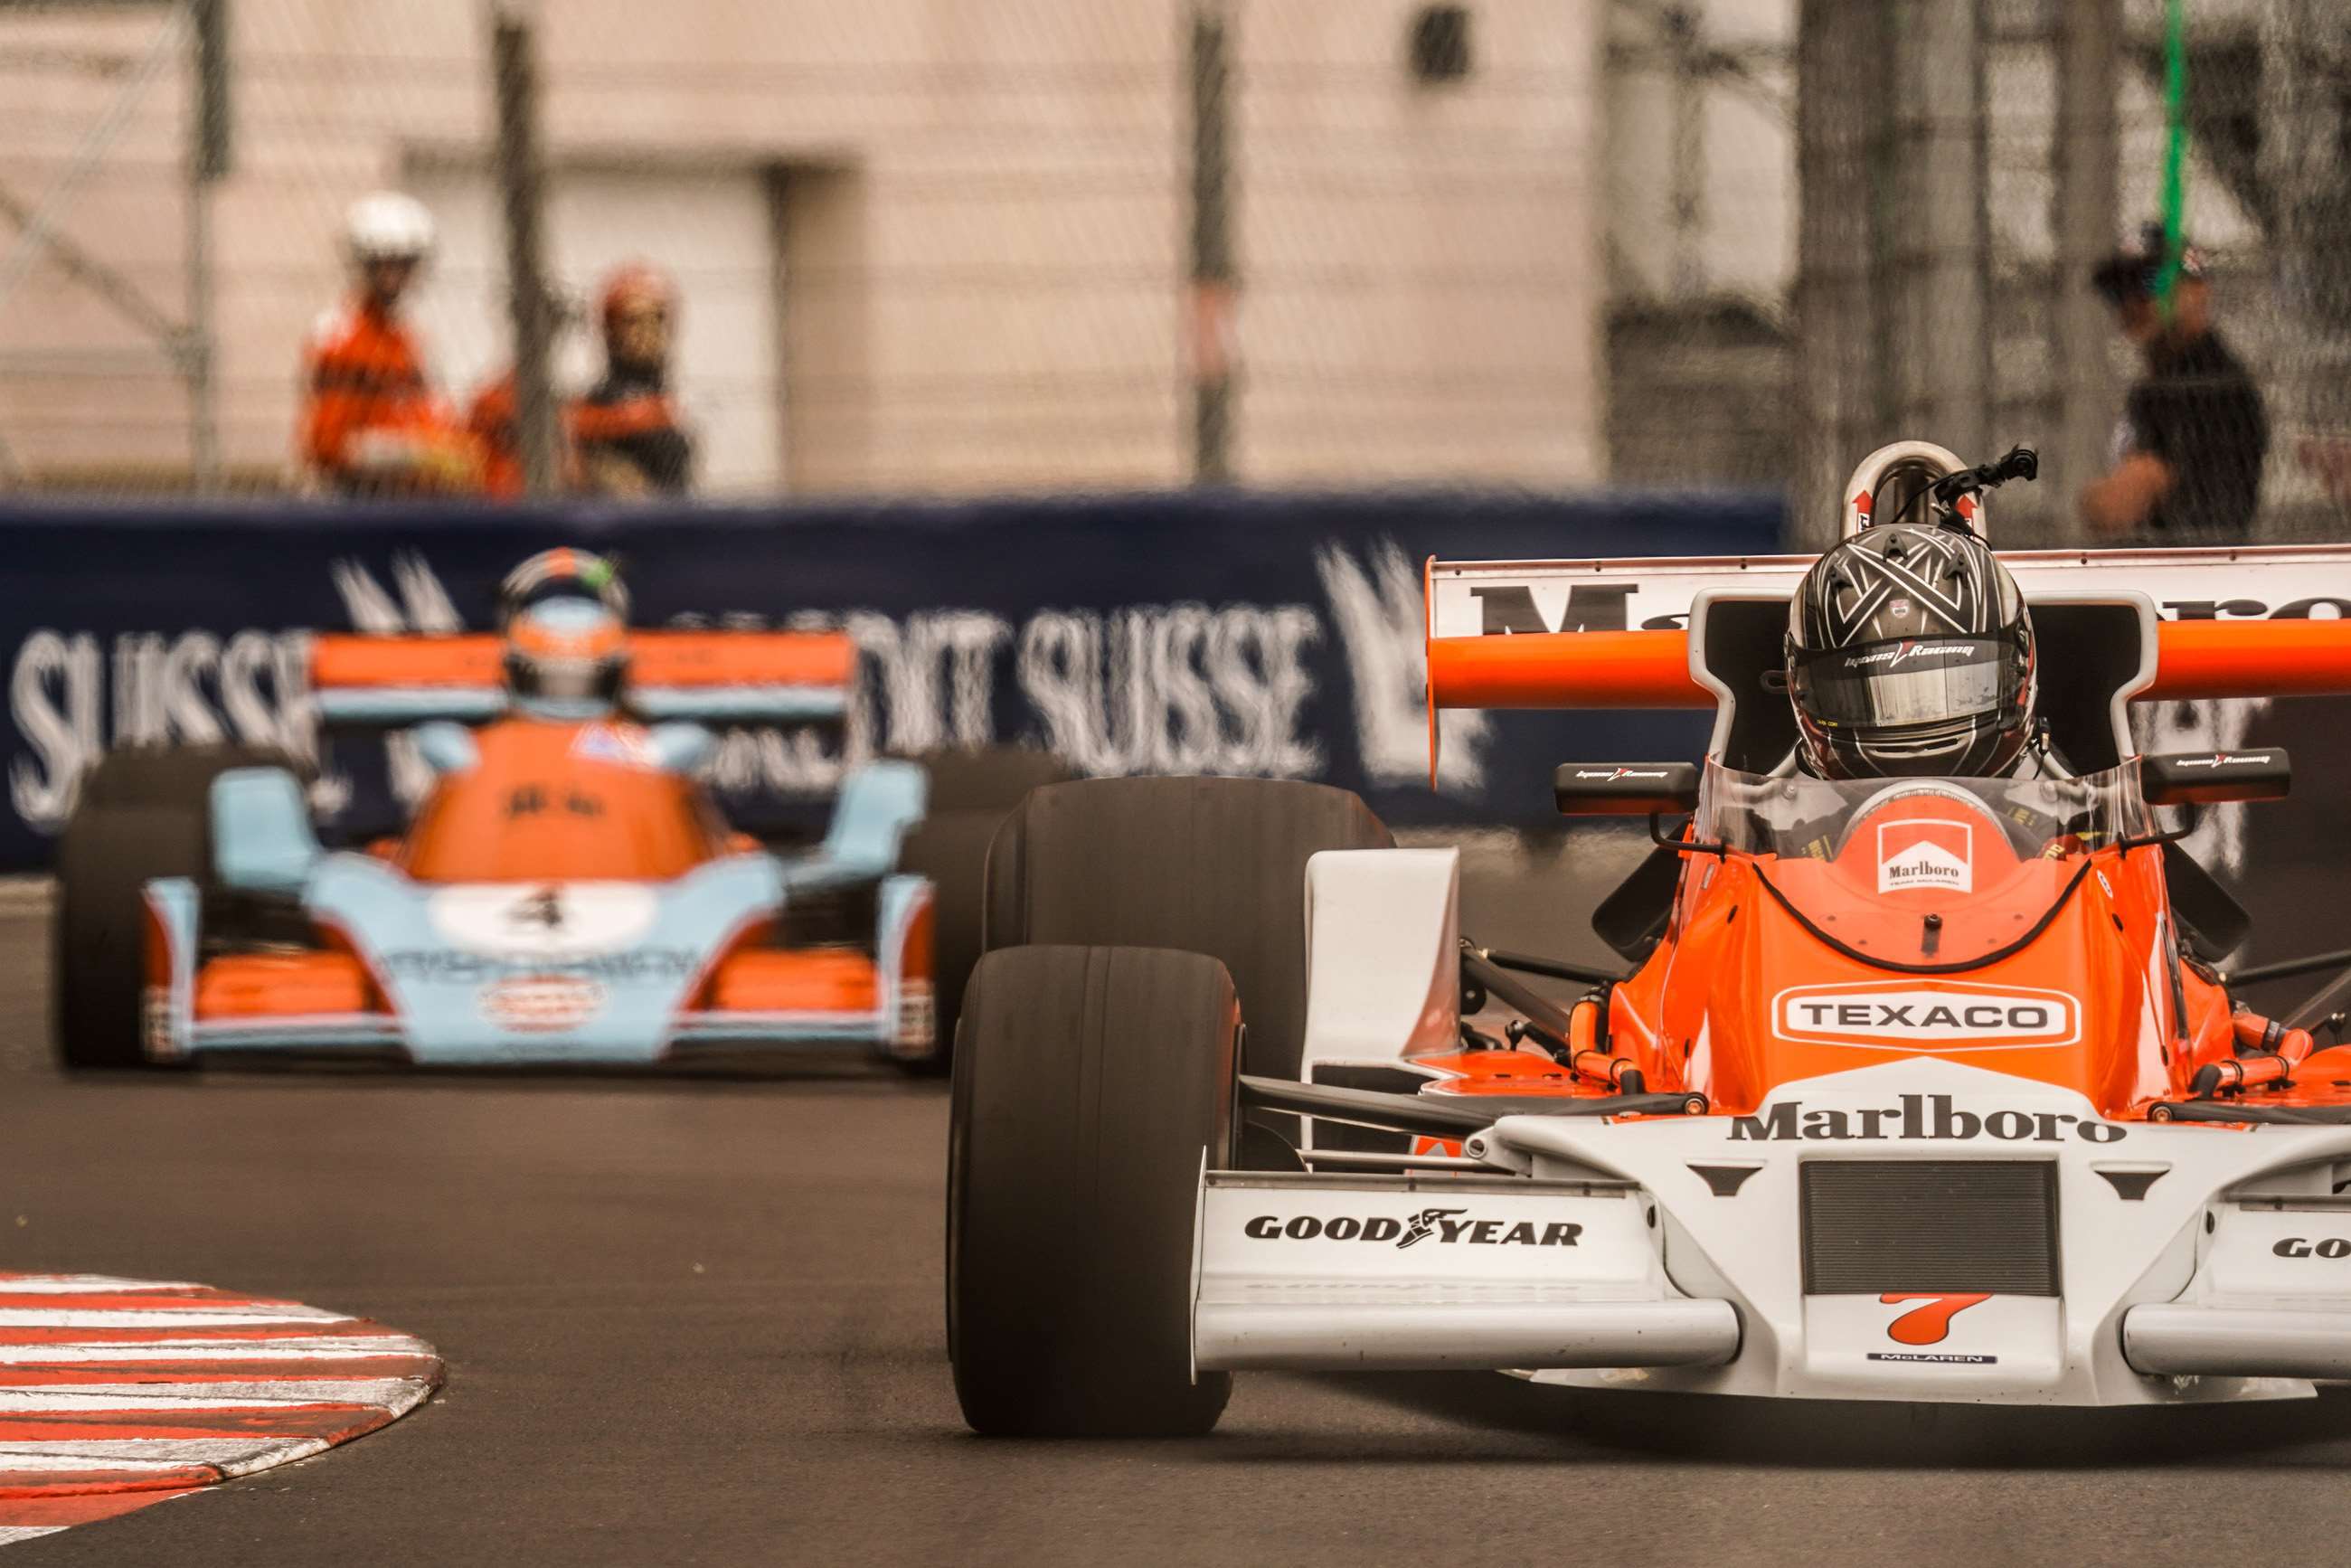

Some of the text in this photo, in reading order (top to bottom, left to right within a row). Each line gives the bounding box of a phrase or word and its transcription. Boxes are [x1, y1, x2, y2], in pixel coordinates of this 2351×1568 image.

[1908, 644, 1975, 657] Racing
[1017, 600, 1324, 778] SUISSE
[1889, 861, 1959, 880] Marlboro
[1799, 1003, 2048, 1029] TEXACO
[1726, 1093, 2128, 1144] Marlboro
[1878, 1292, 1996, 1346] 7
